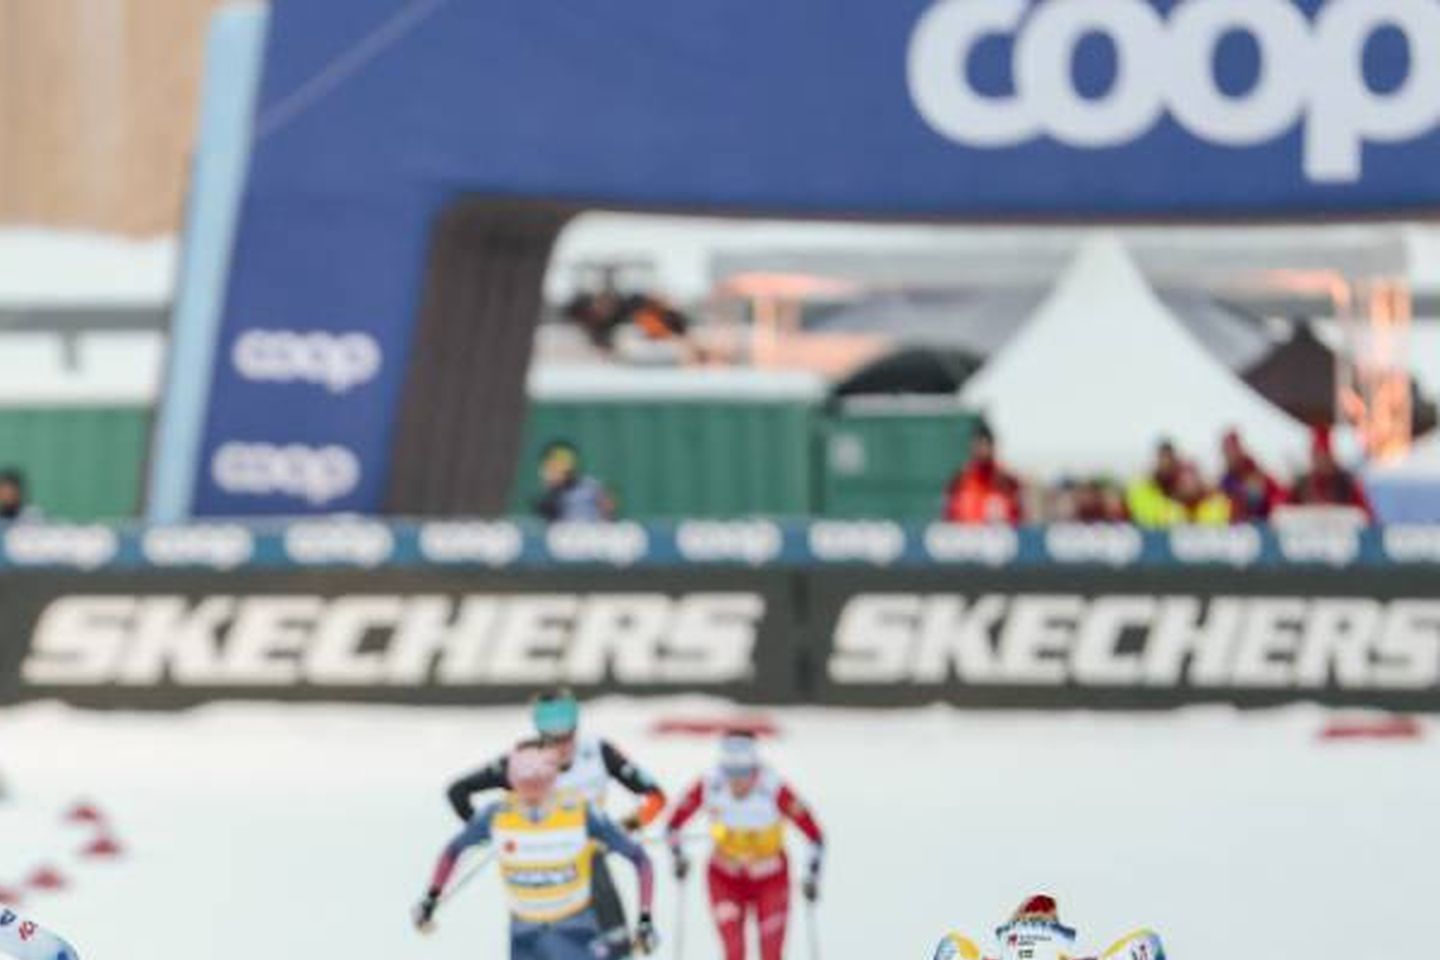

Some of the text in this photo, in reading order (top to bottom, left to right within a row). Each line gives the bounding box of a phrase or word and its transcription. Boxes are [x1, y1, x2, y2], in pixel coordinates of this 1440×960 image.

[906, 0, 1440, 182] coop
[20, 594, 765, 685] SKECHERS
[827, 594, 1440, 689] SKECHERS
